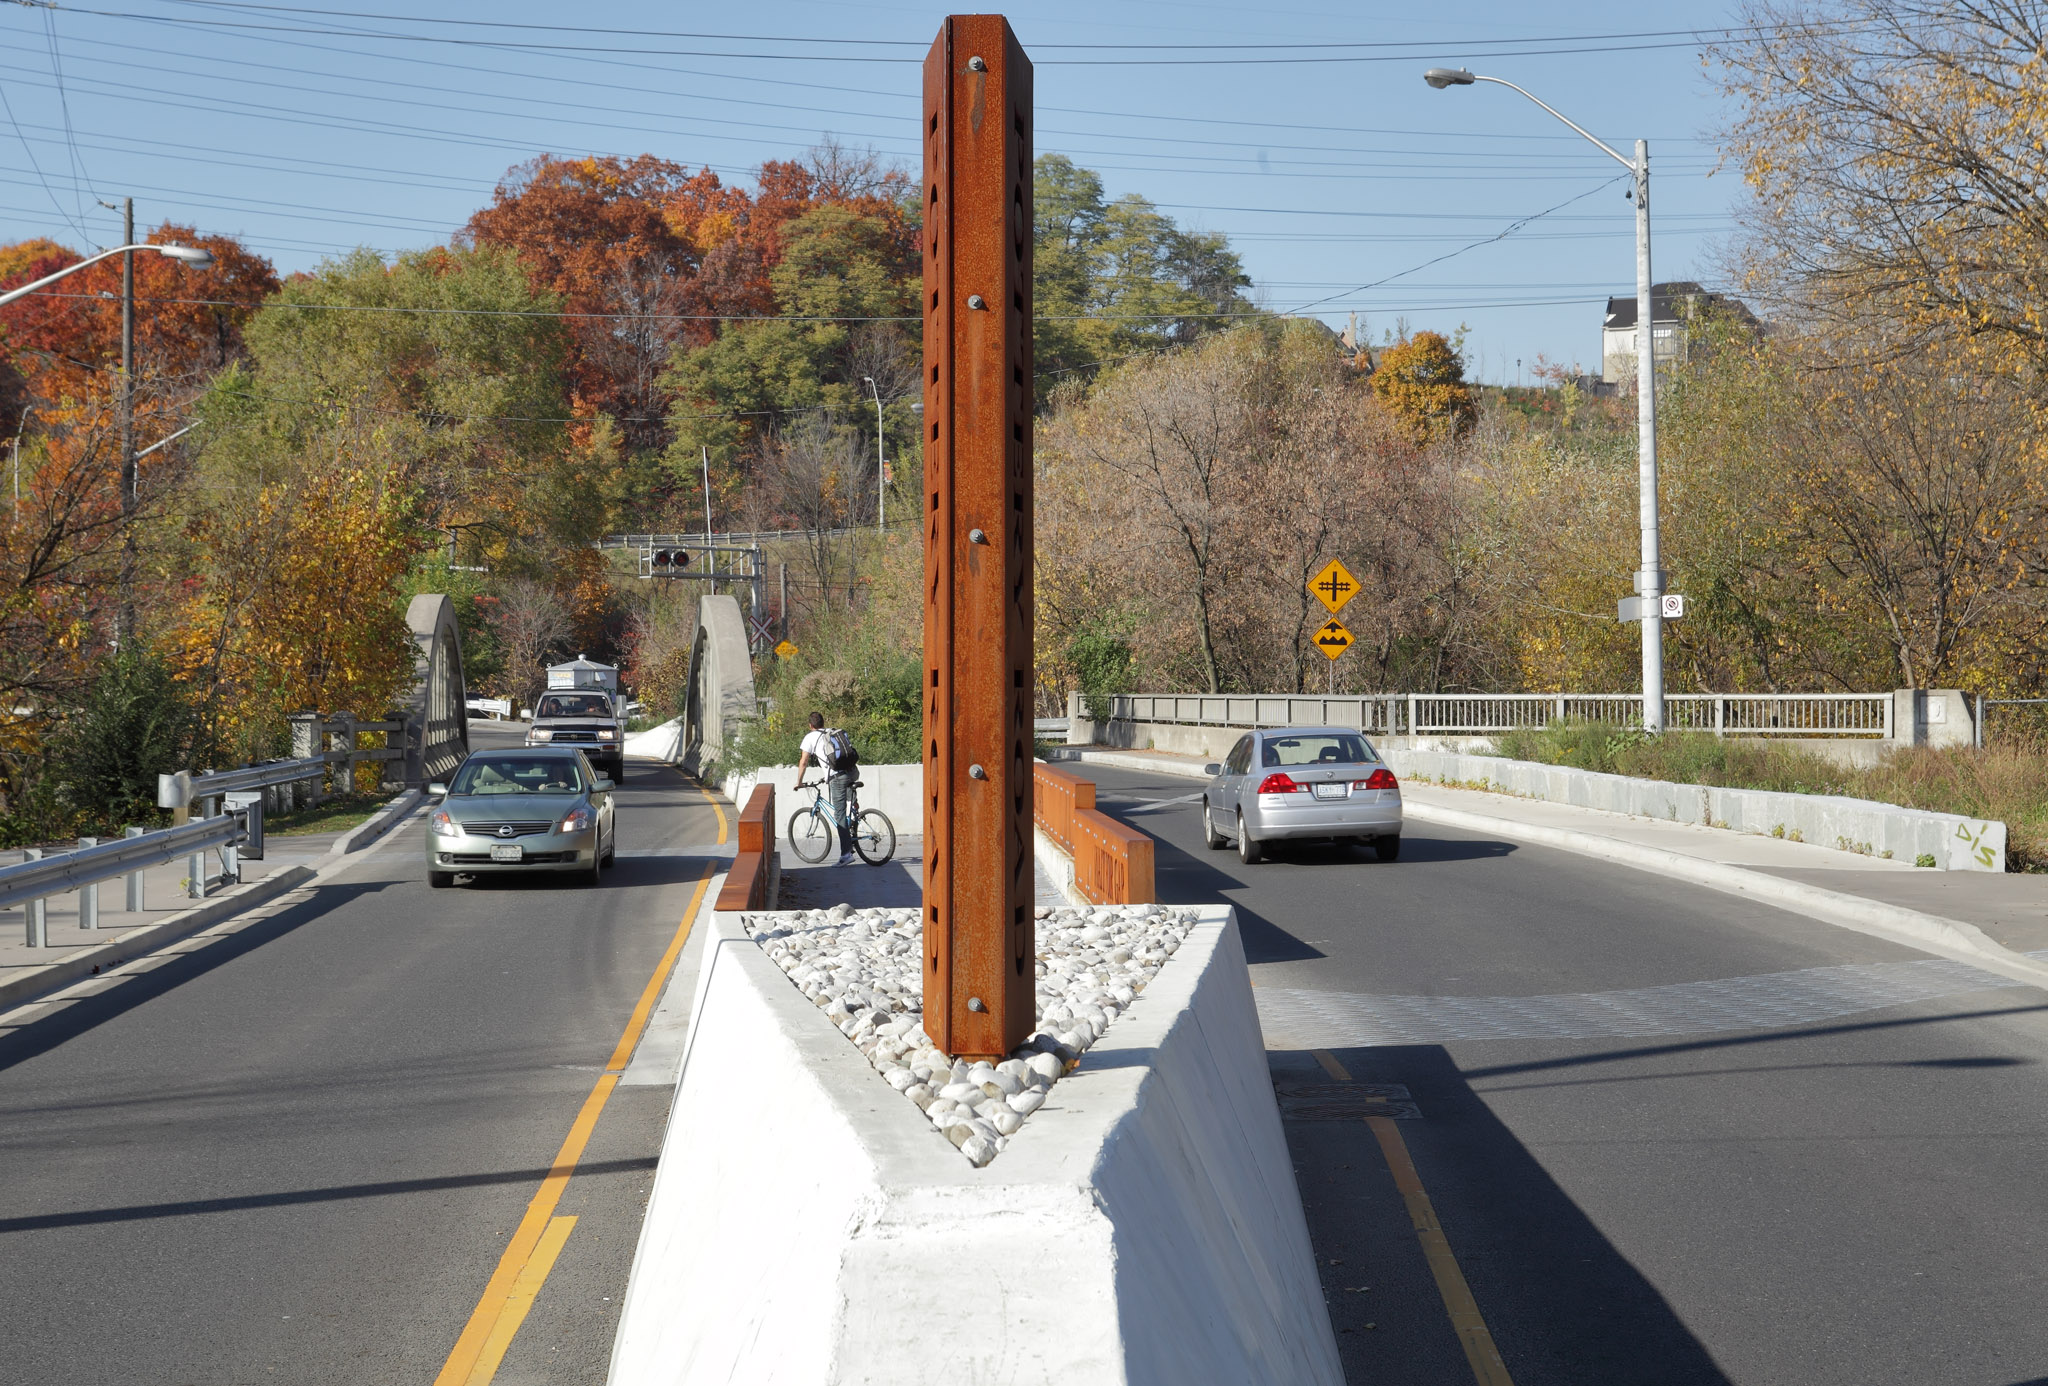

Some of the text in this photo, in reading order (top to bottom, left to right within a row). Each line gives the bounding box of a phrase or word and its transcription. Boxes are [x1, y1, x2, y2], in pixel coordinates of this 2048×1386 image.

[930, 108, 940, 975] POTTERY ROAD
[1013, 103, 1025, 977] POTTERY ROAD
